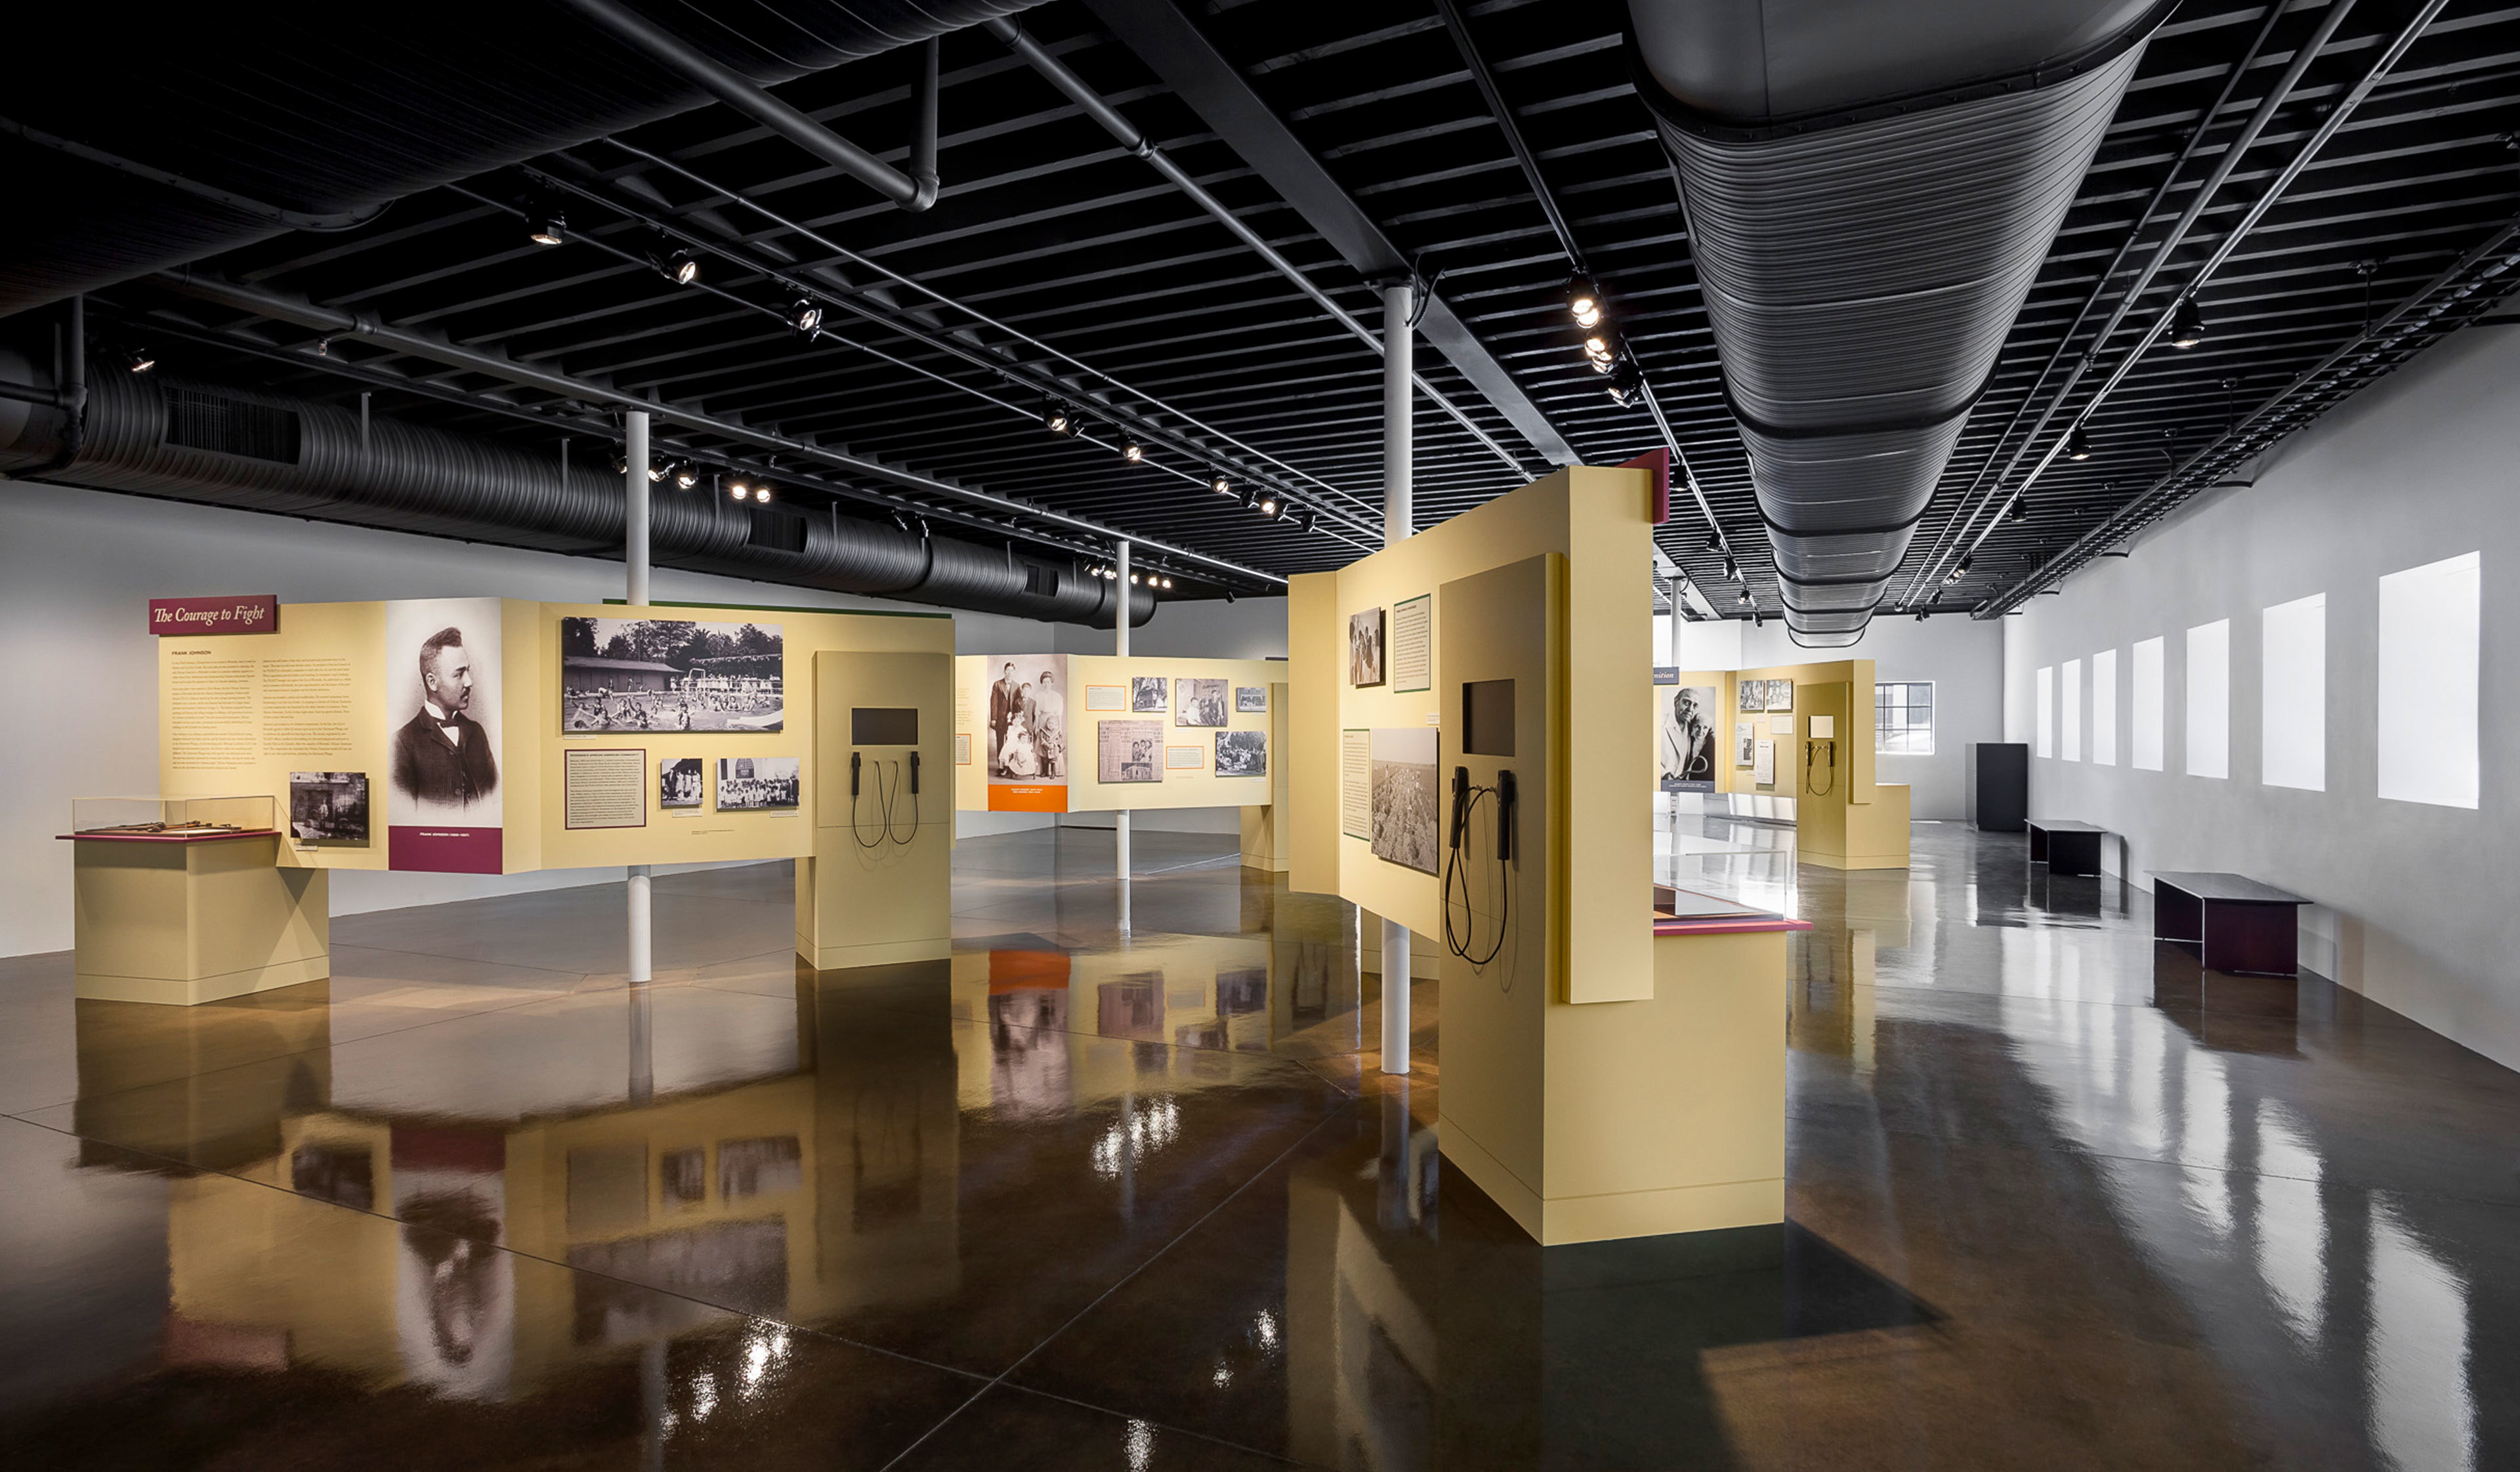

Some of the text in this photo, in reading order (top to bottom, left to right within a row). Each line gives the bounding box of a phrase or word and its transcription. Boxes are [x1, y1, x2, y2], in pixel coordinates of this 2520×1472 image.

[154, 604, 265, 627] The Courage to Fight
